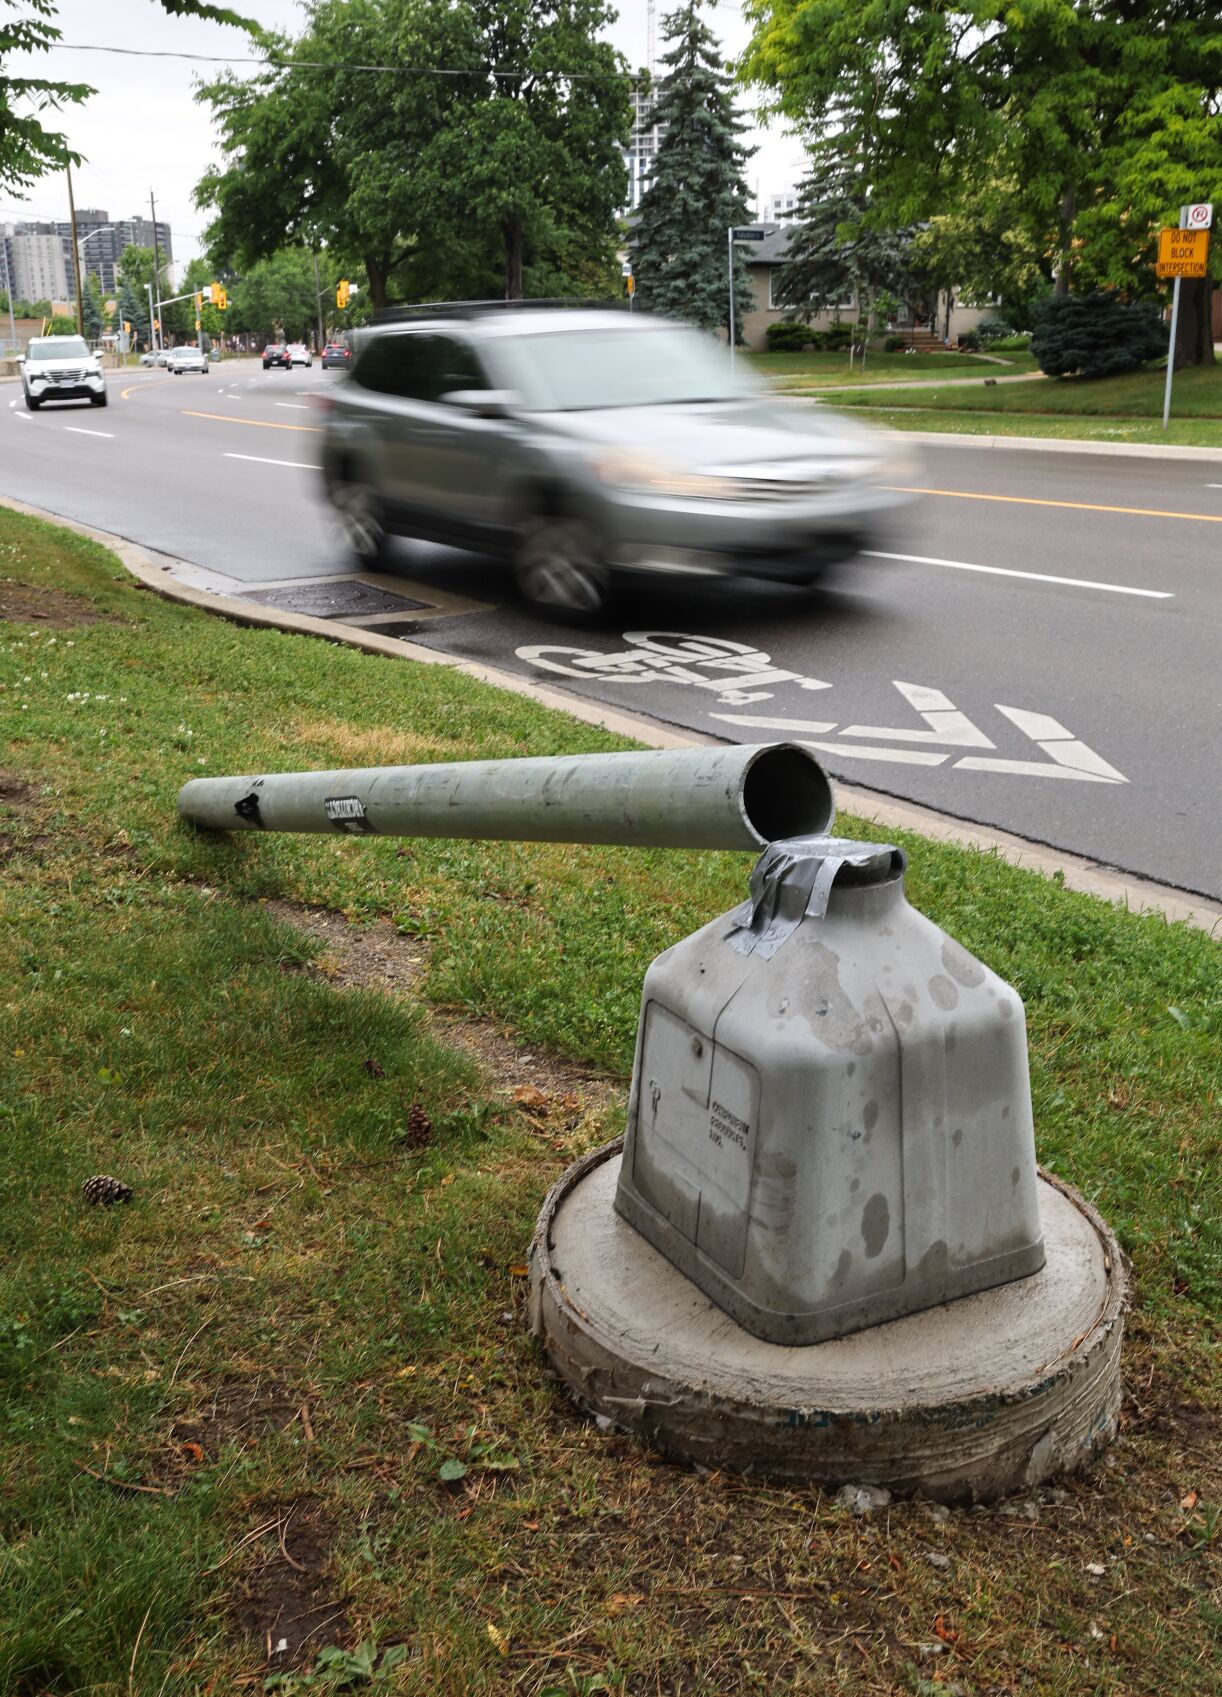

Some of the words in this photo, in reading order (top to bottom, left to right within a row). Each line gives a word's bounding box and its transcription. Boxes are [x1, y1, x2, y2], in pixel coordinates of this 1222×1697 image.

[1171, 232, 1181, 243] DO
[1183, 231, 1197, 243] NOT
[1171, 247, 1194, 258] BLOCK
[1158, 262, 1204, 273] INTERSECTION
